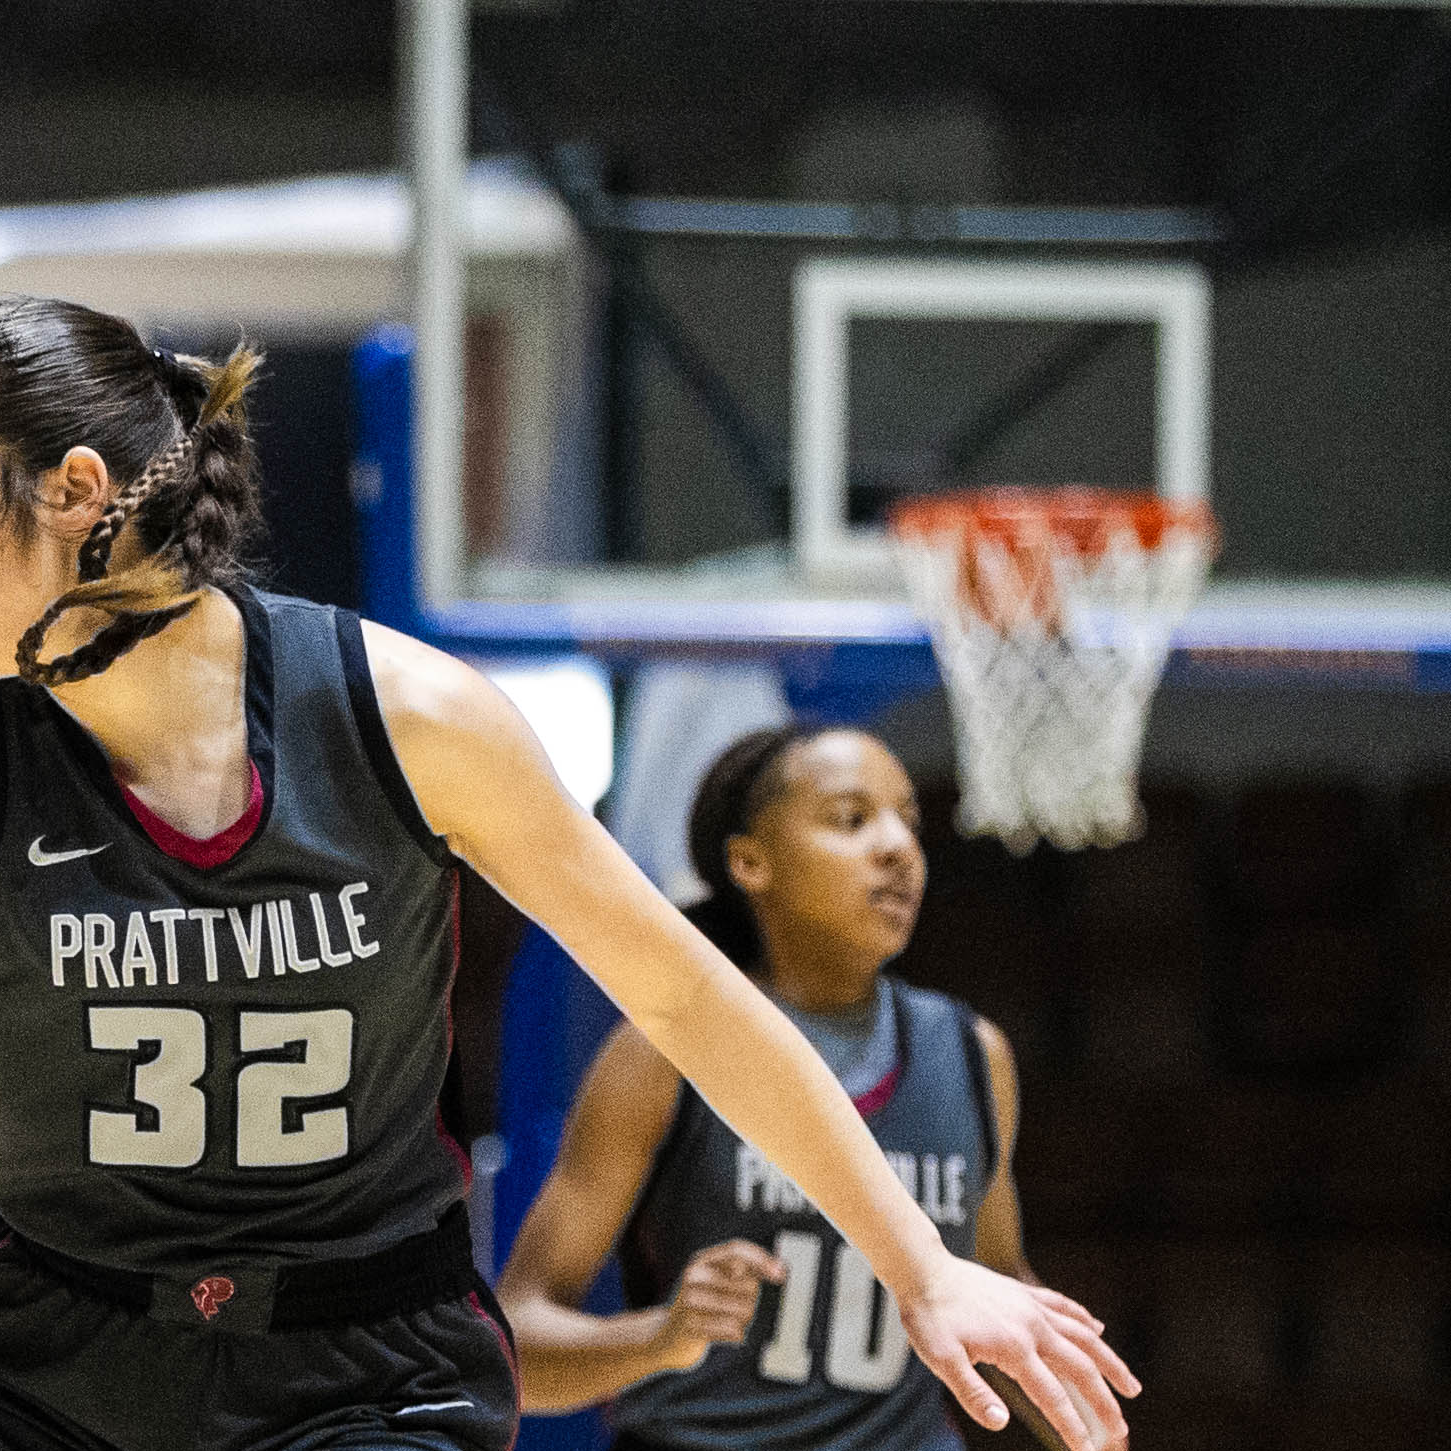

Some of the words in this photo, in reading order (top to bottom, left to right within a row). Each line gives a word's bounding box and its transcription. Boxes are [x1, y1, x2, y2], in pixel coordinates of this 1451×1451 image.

[50, 881, 380, 988] PRATTVILLE
[88, 1006, 353, 1168] 32
[758, 1230, 910, 1393] 10
